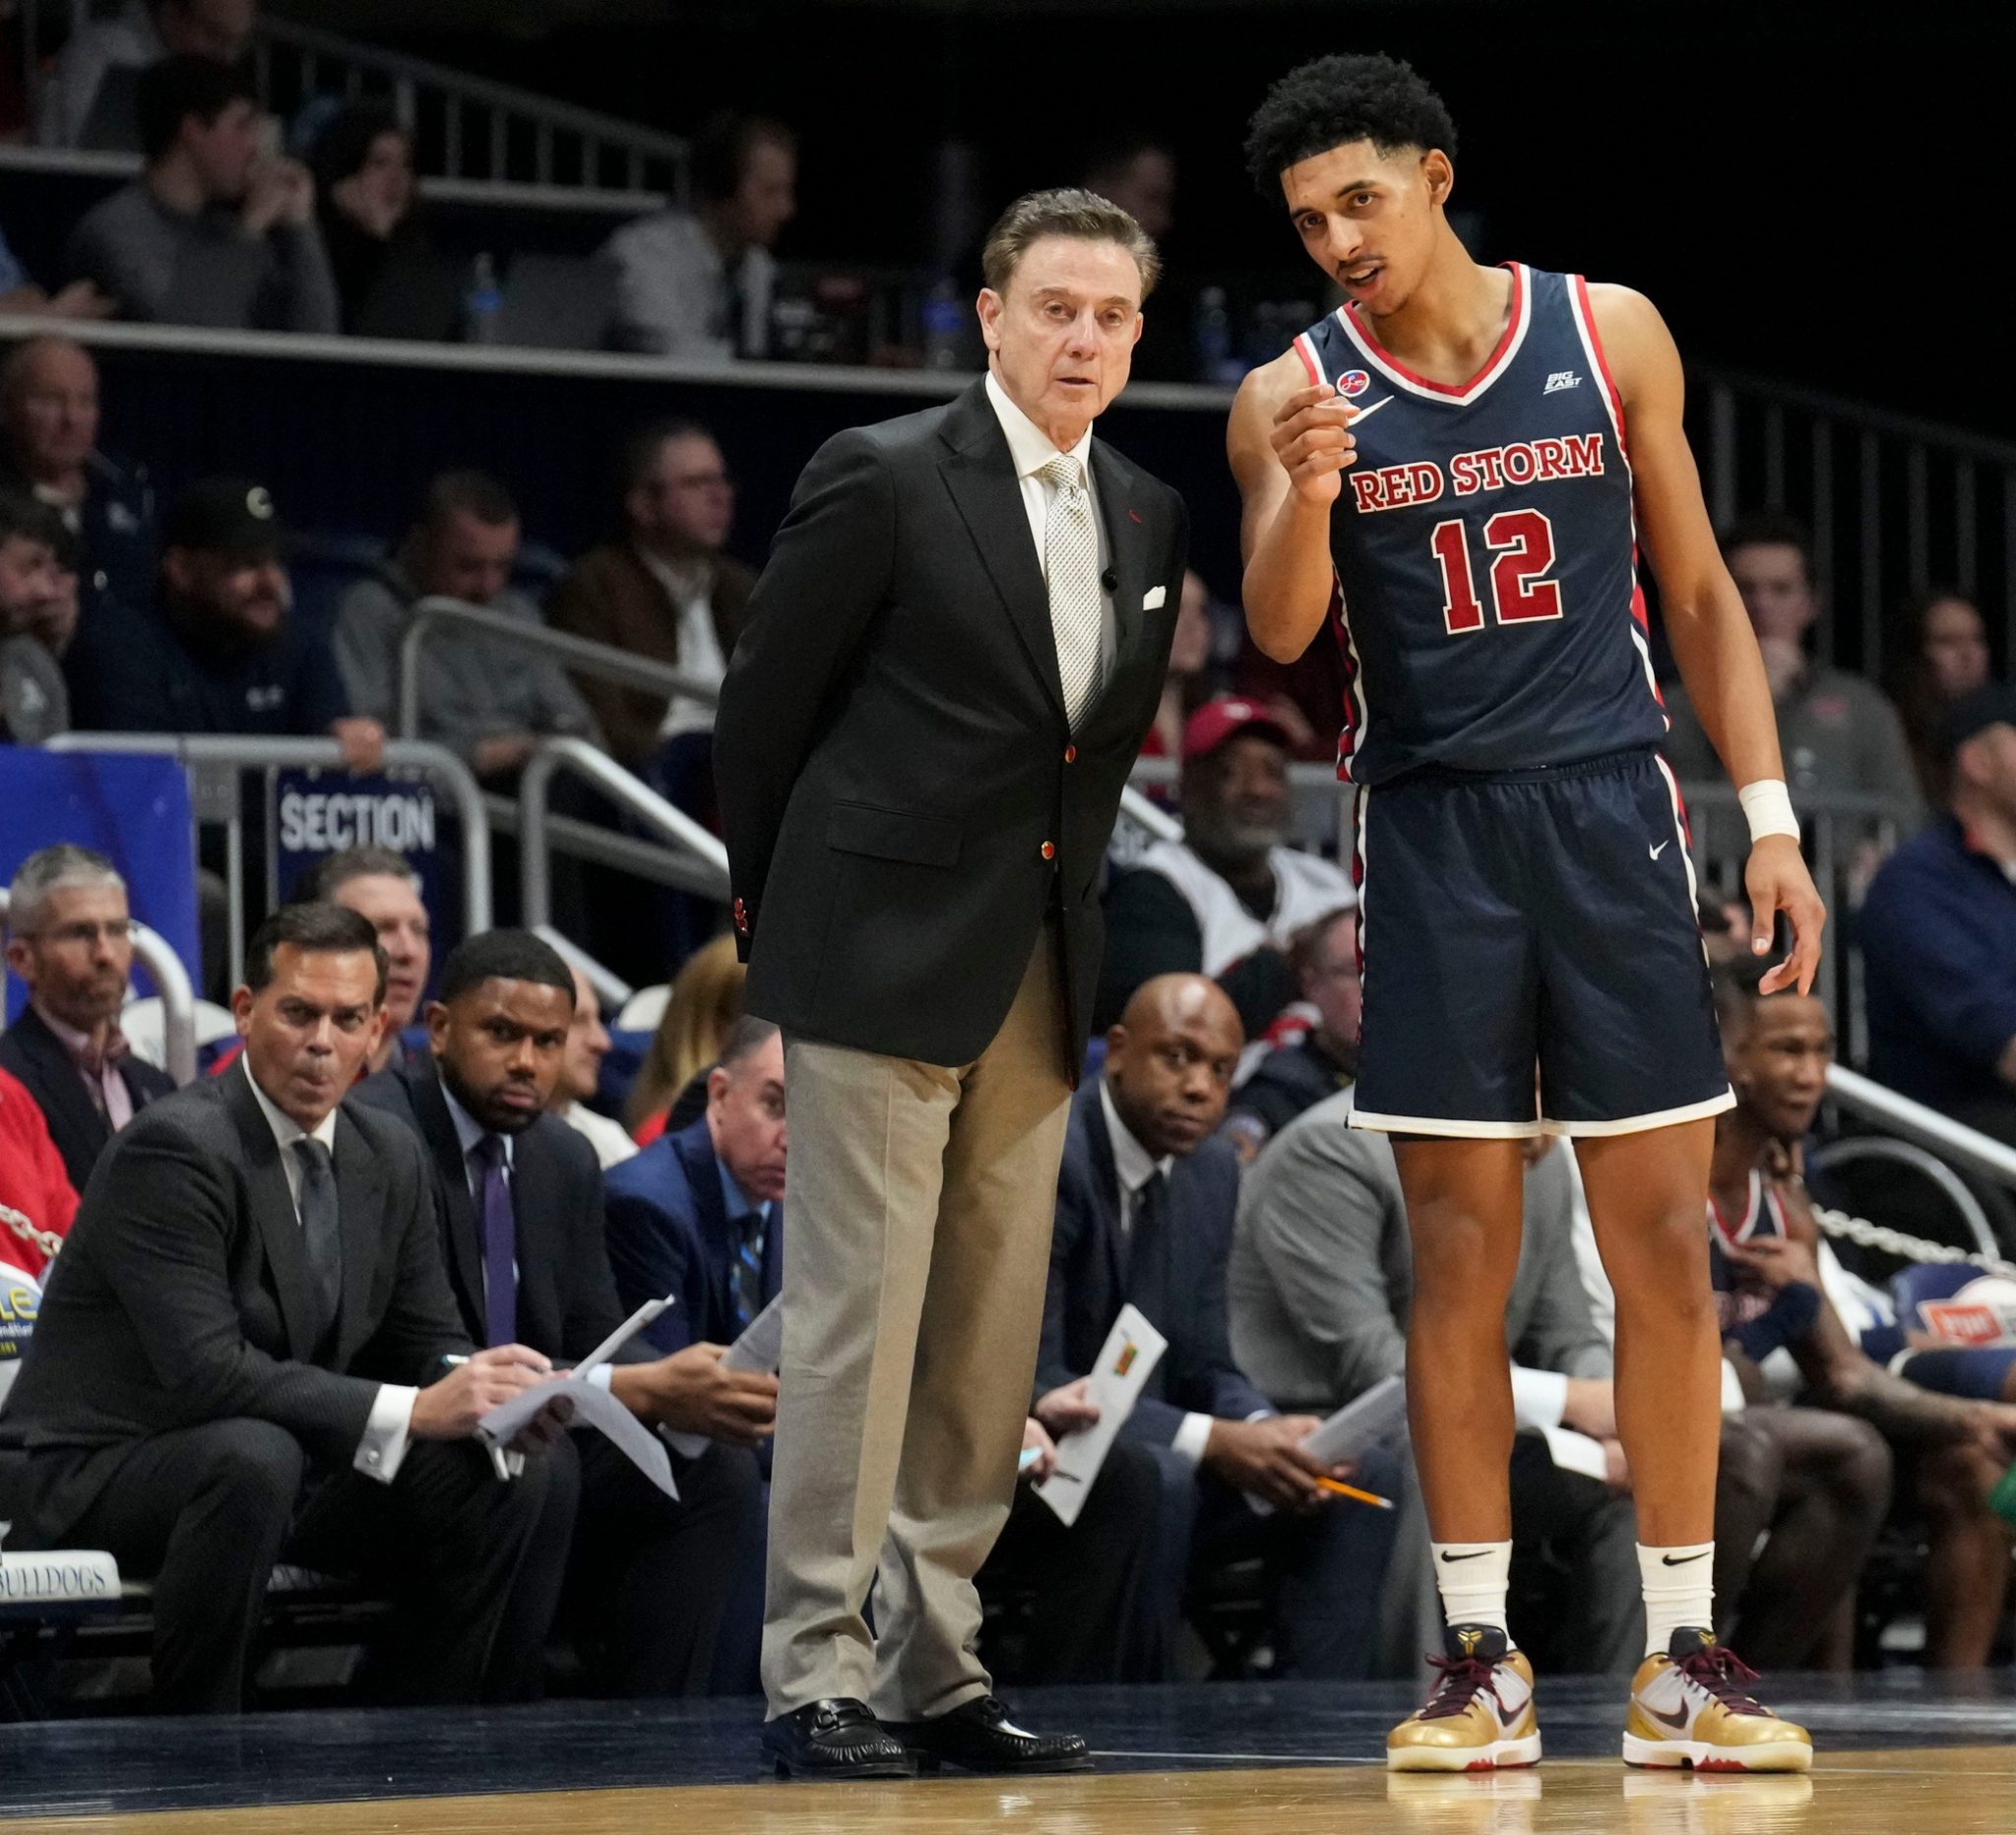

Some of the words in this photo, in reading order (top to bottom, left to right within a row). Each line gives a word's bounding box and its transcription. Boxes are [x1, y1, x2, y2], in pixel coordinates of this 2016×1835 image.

[1544, 377, 1583, 390] EAST
[1547, 370, 1574, 382] BIG
[1350, 461, 1444, 513] RED
[1450, 433, 1605, 496] STORM
[1430, 508, 1563, 635] 12
[281, 792, 435, 852] SECTION
